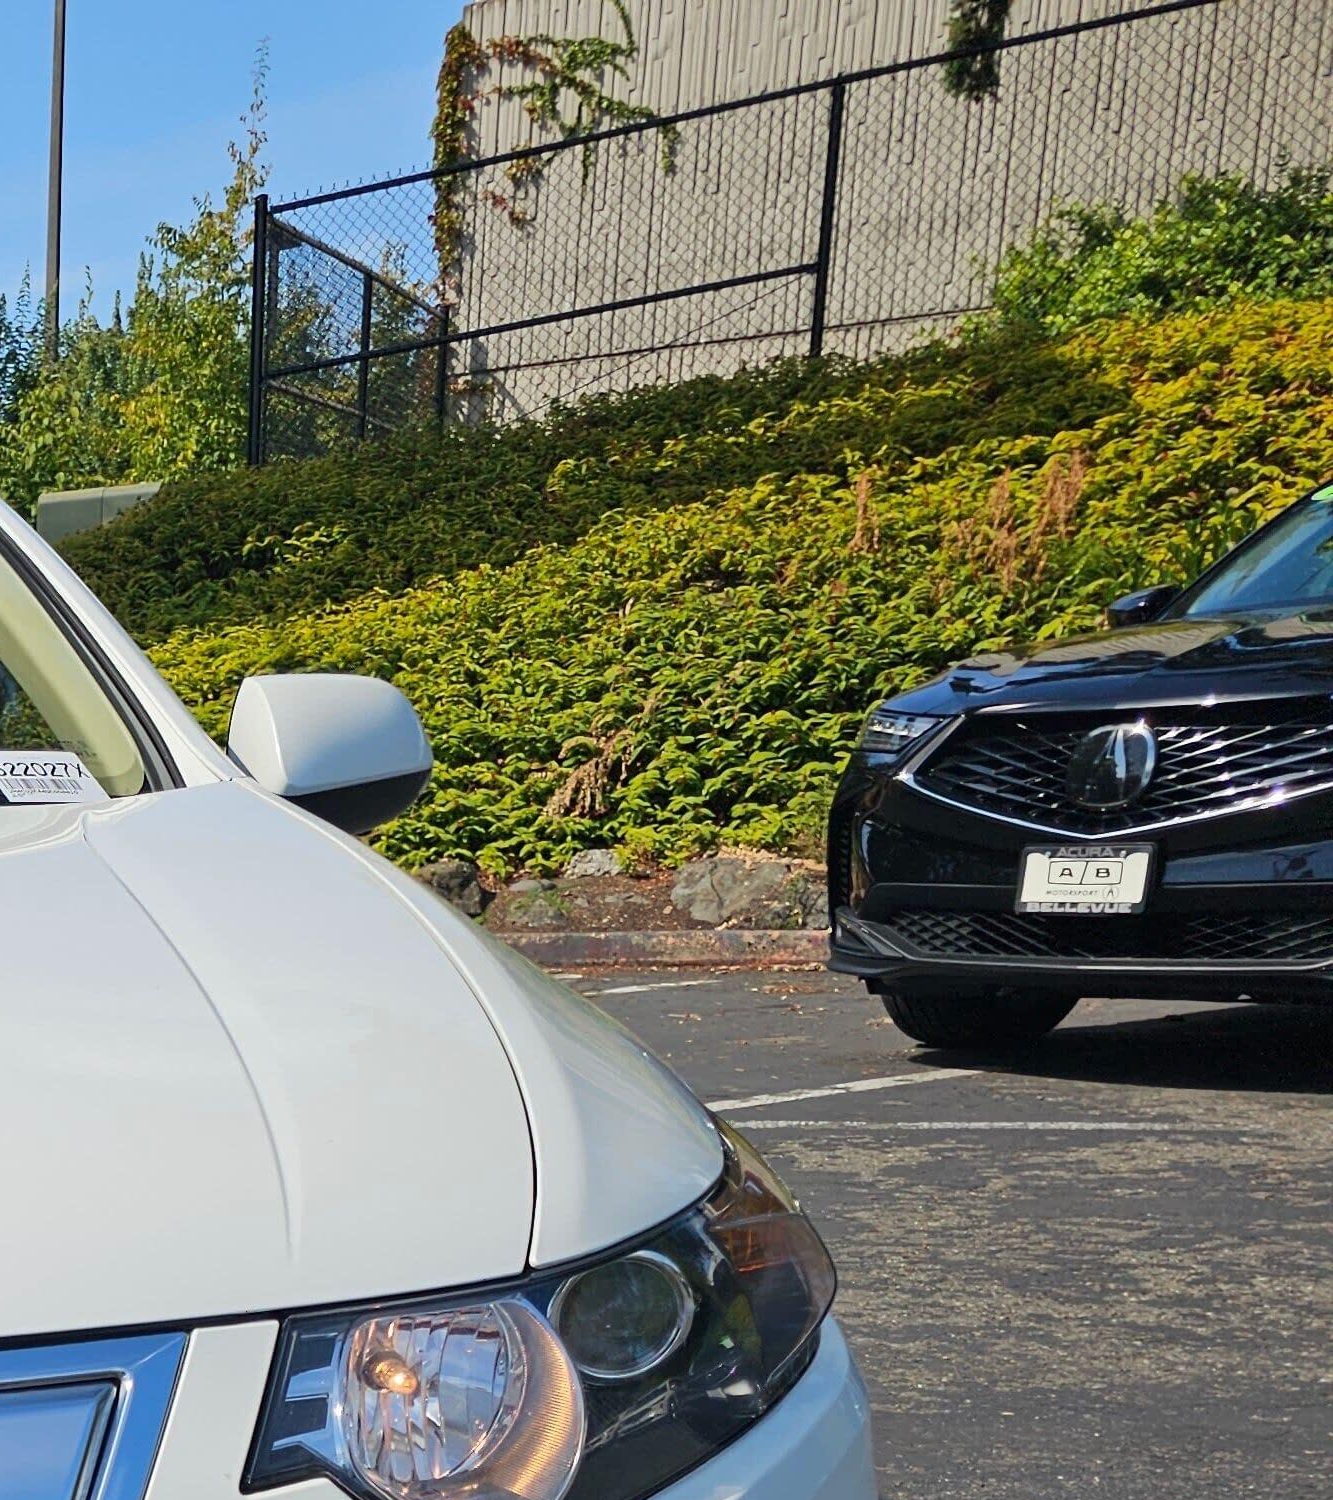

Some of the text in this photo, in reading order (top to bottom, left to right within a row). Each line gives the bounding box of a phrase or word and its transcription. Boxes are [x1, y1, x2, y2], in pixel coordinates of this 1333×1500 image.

[1056, 847, 1114, 857] ACURA
[1059, 868, 1111, 878] A B
[1026, 902, 1133, 914] BELLEVUE
